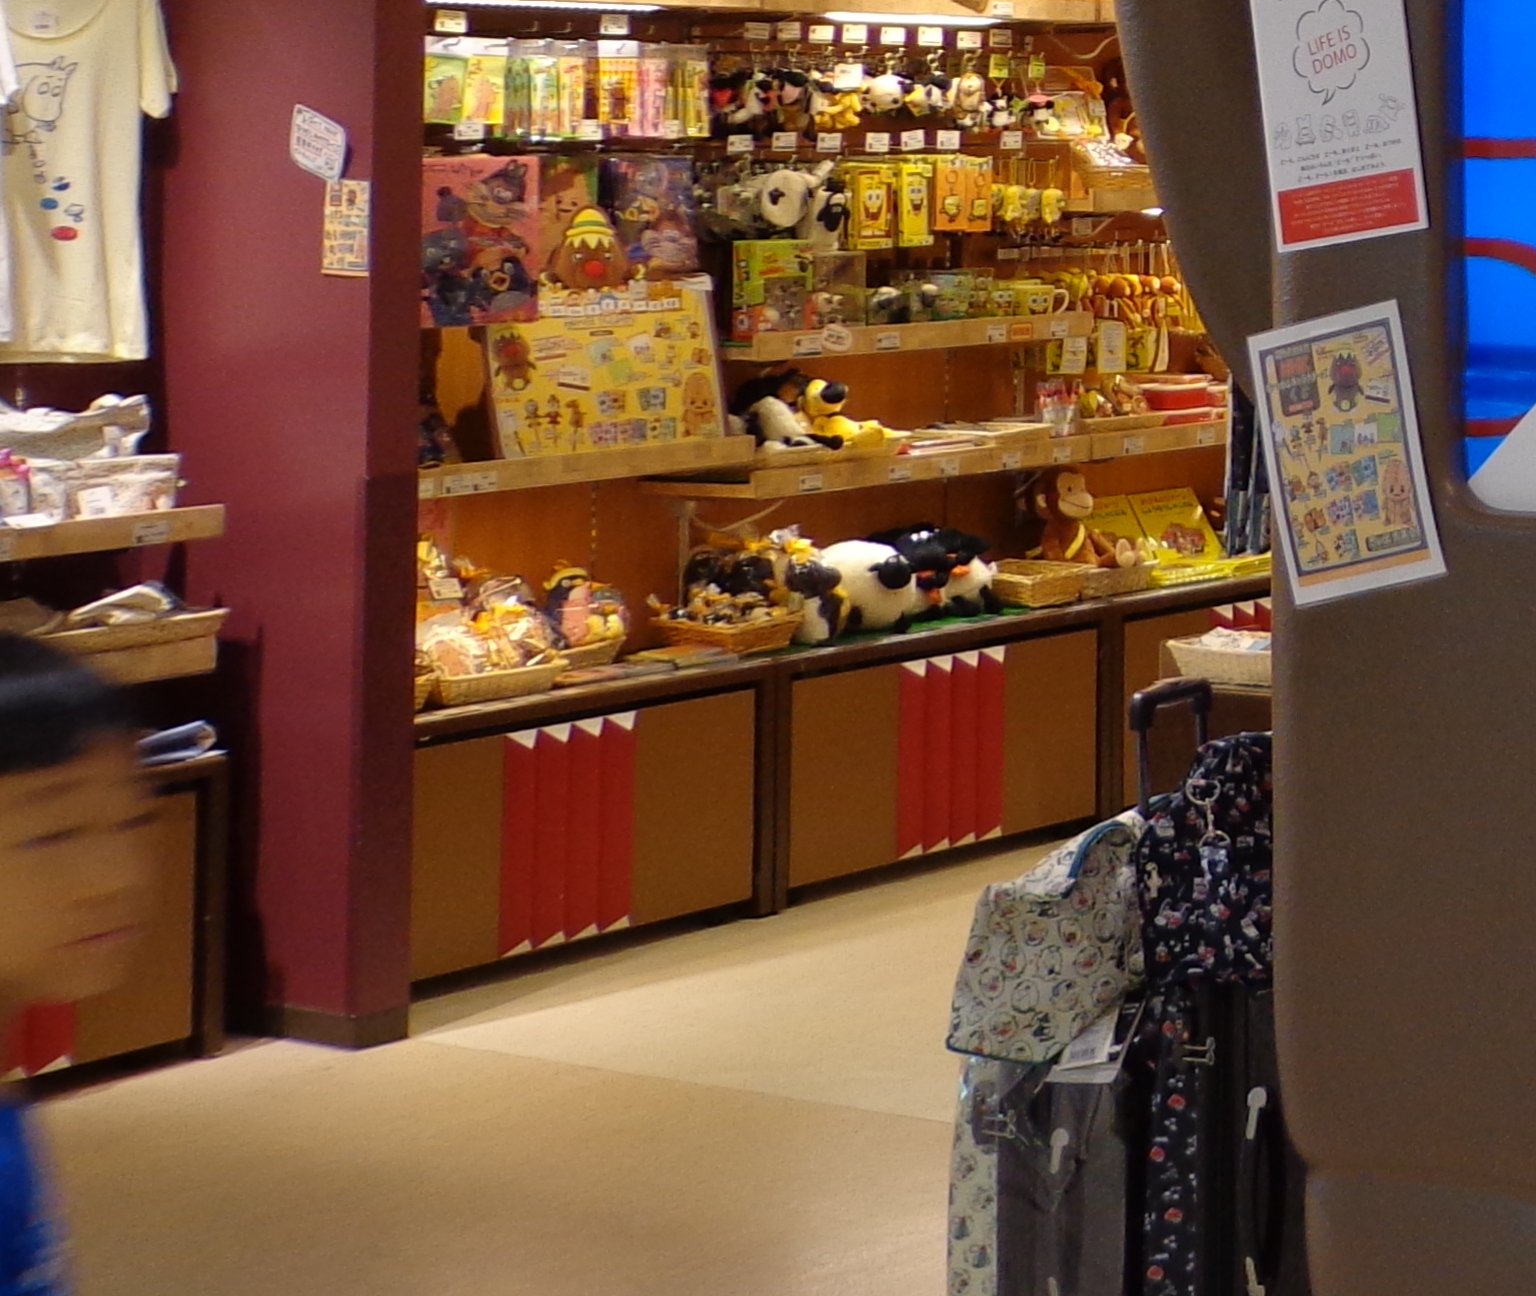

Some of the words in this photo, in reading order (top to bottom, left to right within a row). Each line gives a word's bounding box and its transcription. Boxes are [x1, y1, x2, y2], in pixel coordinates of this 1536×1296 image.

[1307, 31, 1336, 57] LIFE
[1337, 24, 1351, 42] IS
[1311, 43, 1357, 75] DOMO
